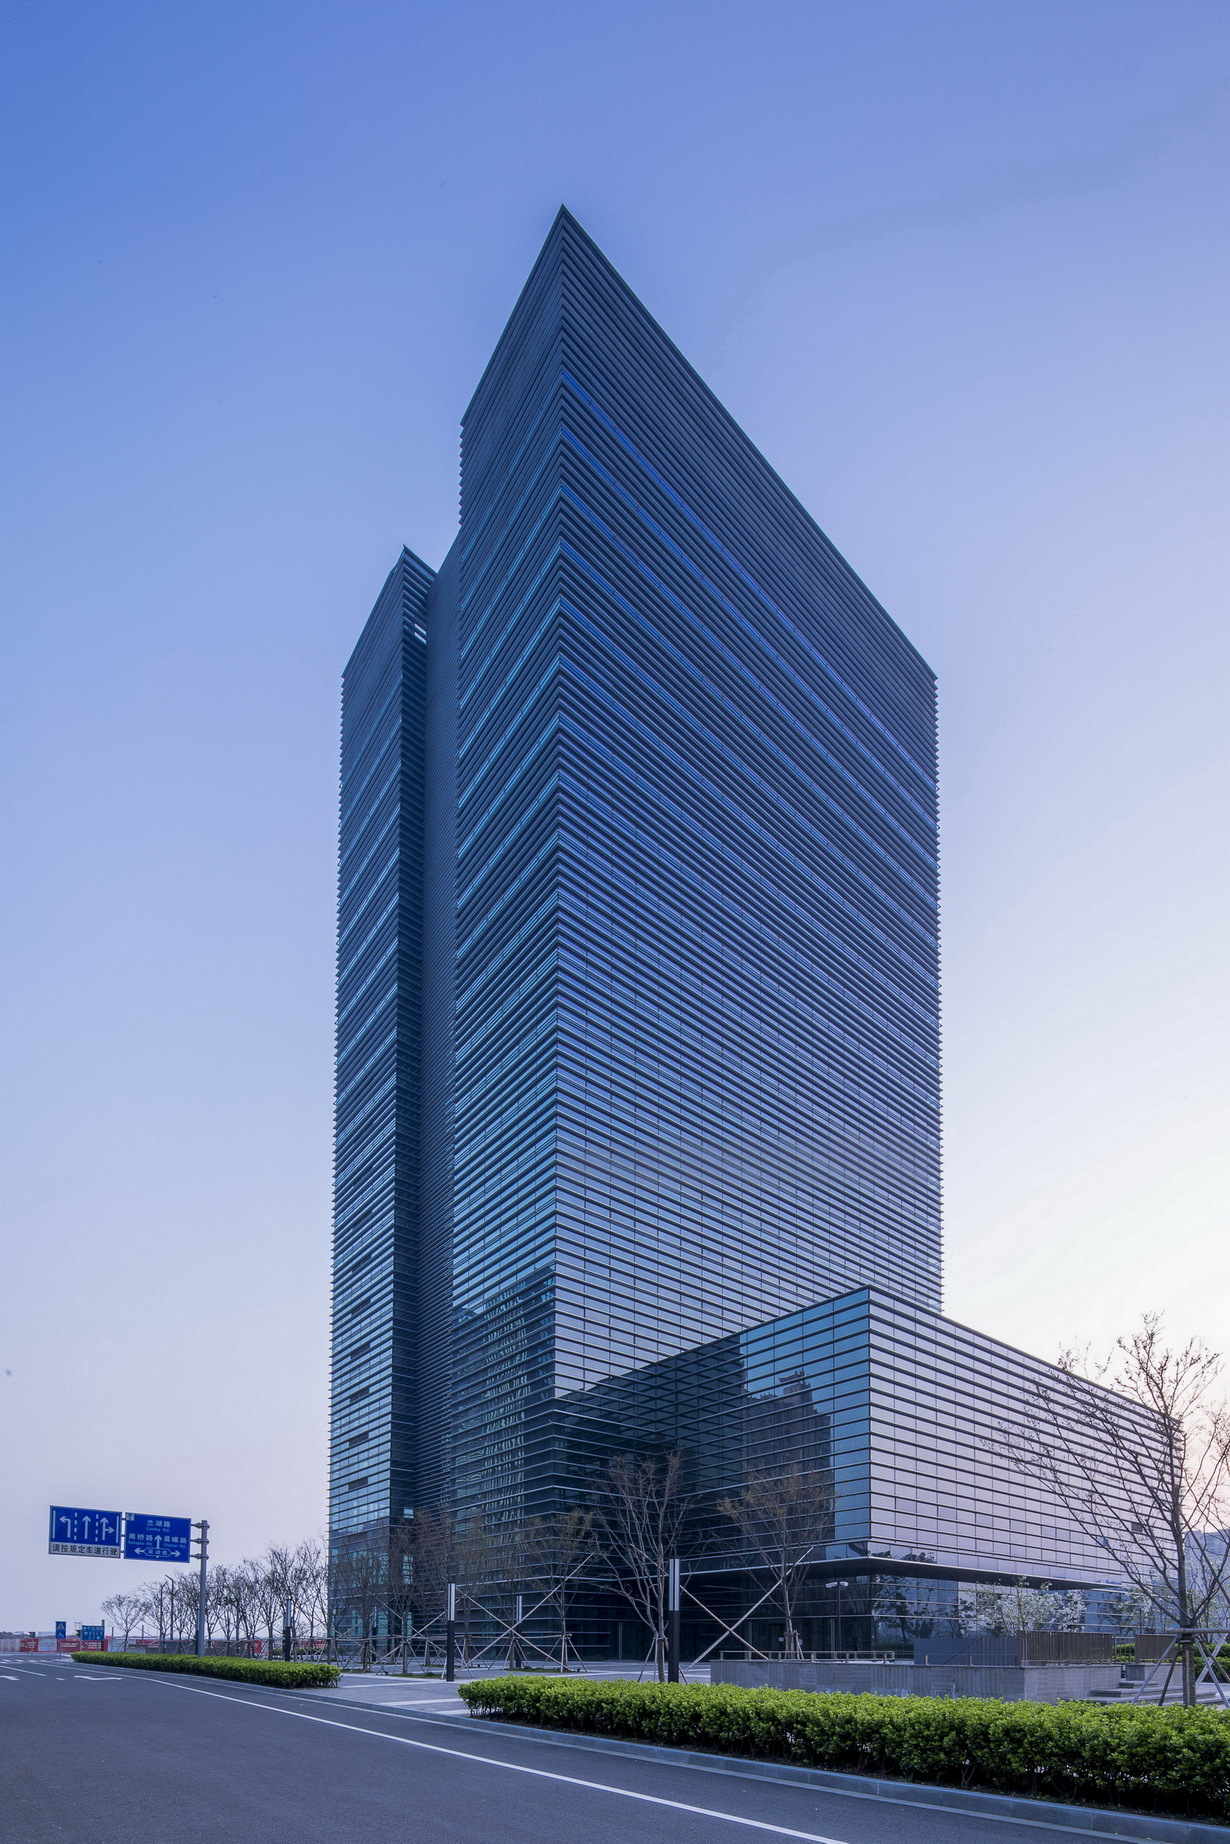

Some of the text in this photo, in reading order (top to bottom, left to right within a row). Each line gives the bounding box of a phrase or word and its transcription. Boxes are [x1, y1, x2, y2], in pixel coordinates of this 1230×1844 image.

[128, 1533, 153, 1542] 南桥路
[52, 1543, 118, 1556] 请按规定车道行驶
